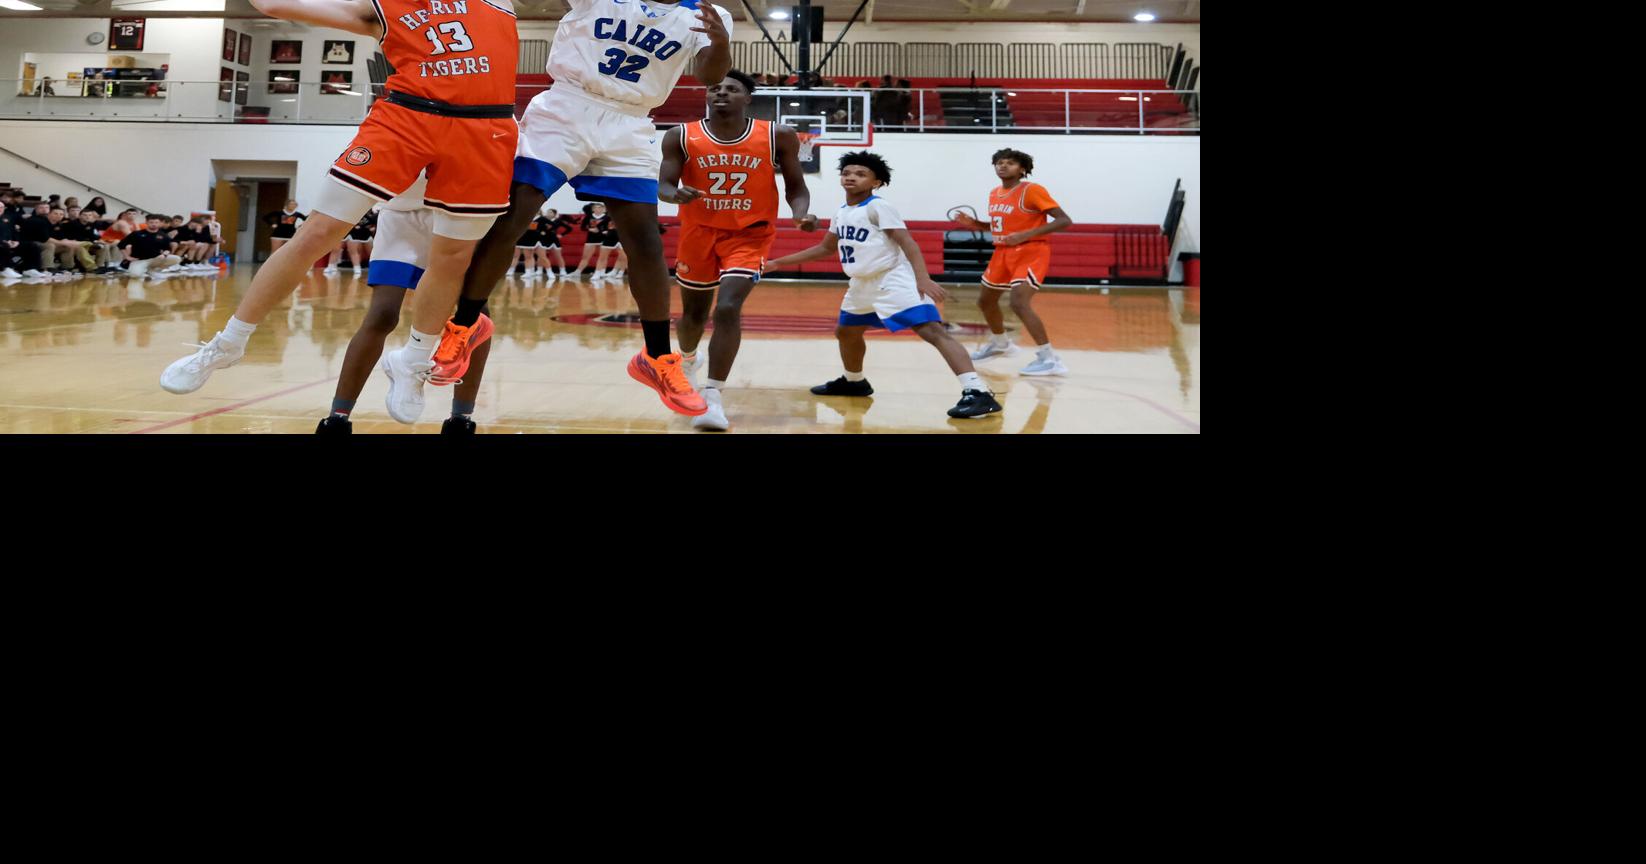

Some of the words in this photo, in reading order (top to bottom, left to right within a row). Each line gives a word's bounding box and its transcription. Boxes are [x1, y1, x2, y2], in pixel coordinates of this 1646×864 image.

[399, 0, 467, 30] HERIN
[121, 26, 134, 36] 12
[424, 20, 474, 56] 13
[418, 56, 490, 77] TIGERS
[598, 47, 650, 83] 32
[696, 153, 762, 169] HERRIN
[708, 171, 748, 195] 22
[840, 245, 856, 263] 12
